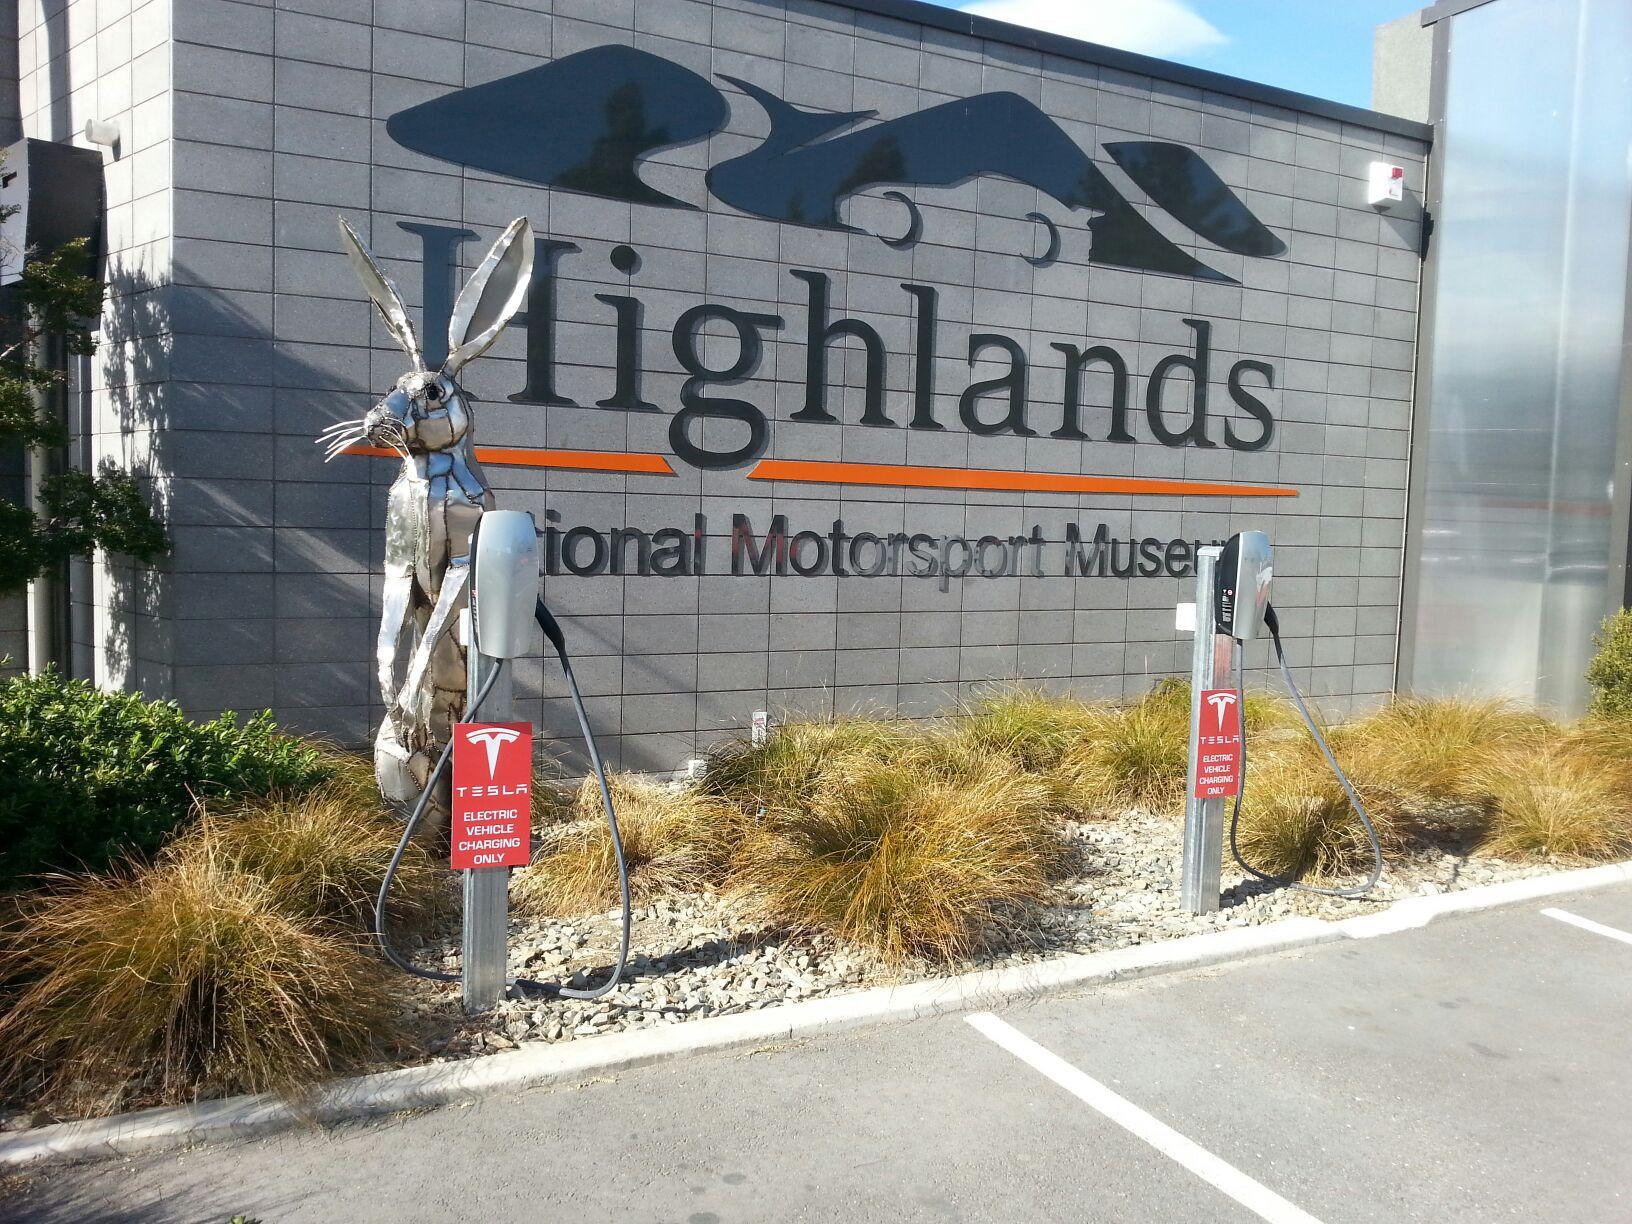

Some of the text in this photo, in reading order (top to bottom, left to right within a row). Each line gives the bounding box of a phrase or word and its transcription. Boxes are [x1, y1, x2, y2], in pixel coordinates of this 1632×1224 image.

[396, 221, 1275, 468] Highlands
[731, 513, 1044, 593] Motorsport
[1200, 735, 1239, 744] TESLA
[1203, 754, 1233, 763] ELECTRIC
[1204, 765, 1231, 773] VEHICLE
[1200, 775, 1233, 785] CHARGING
[456, 784, 528, 798] TESLA
[1208, 787, 1225, 795] ONLY
[463, 809, 518, 822] ELECTRIC
[466, 823, 514, 836] VEHICLE
[458, 837, 521, 851] CHARGING
[473, 853, 505, 865] ONLY
